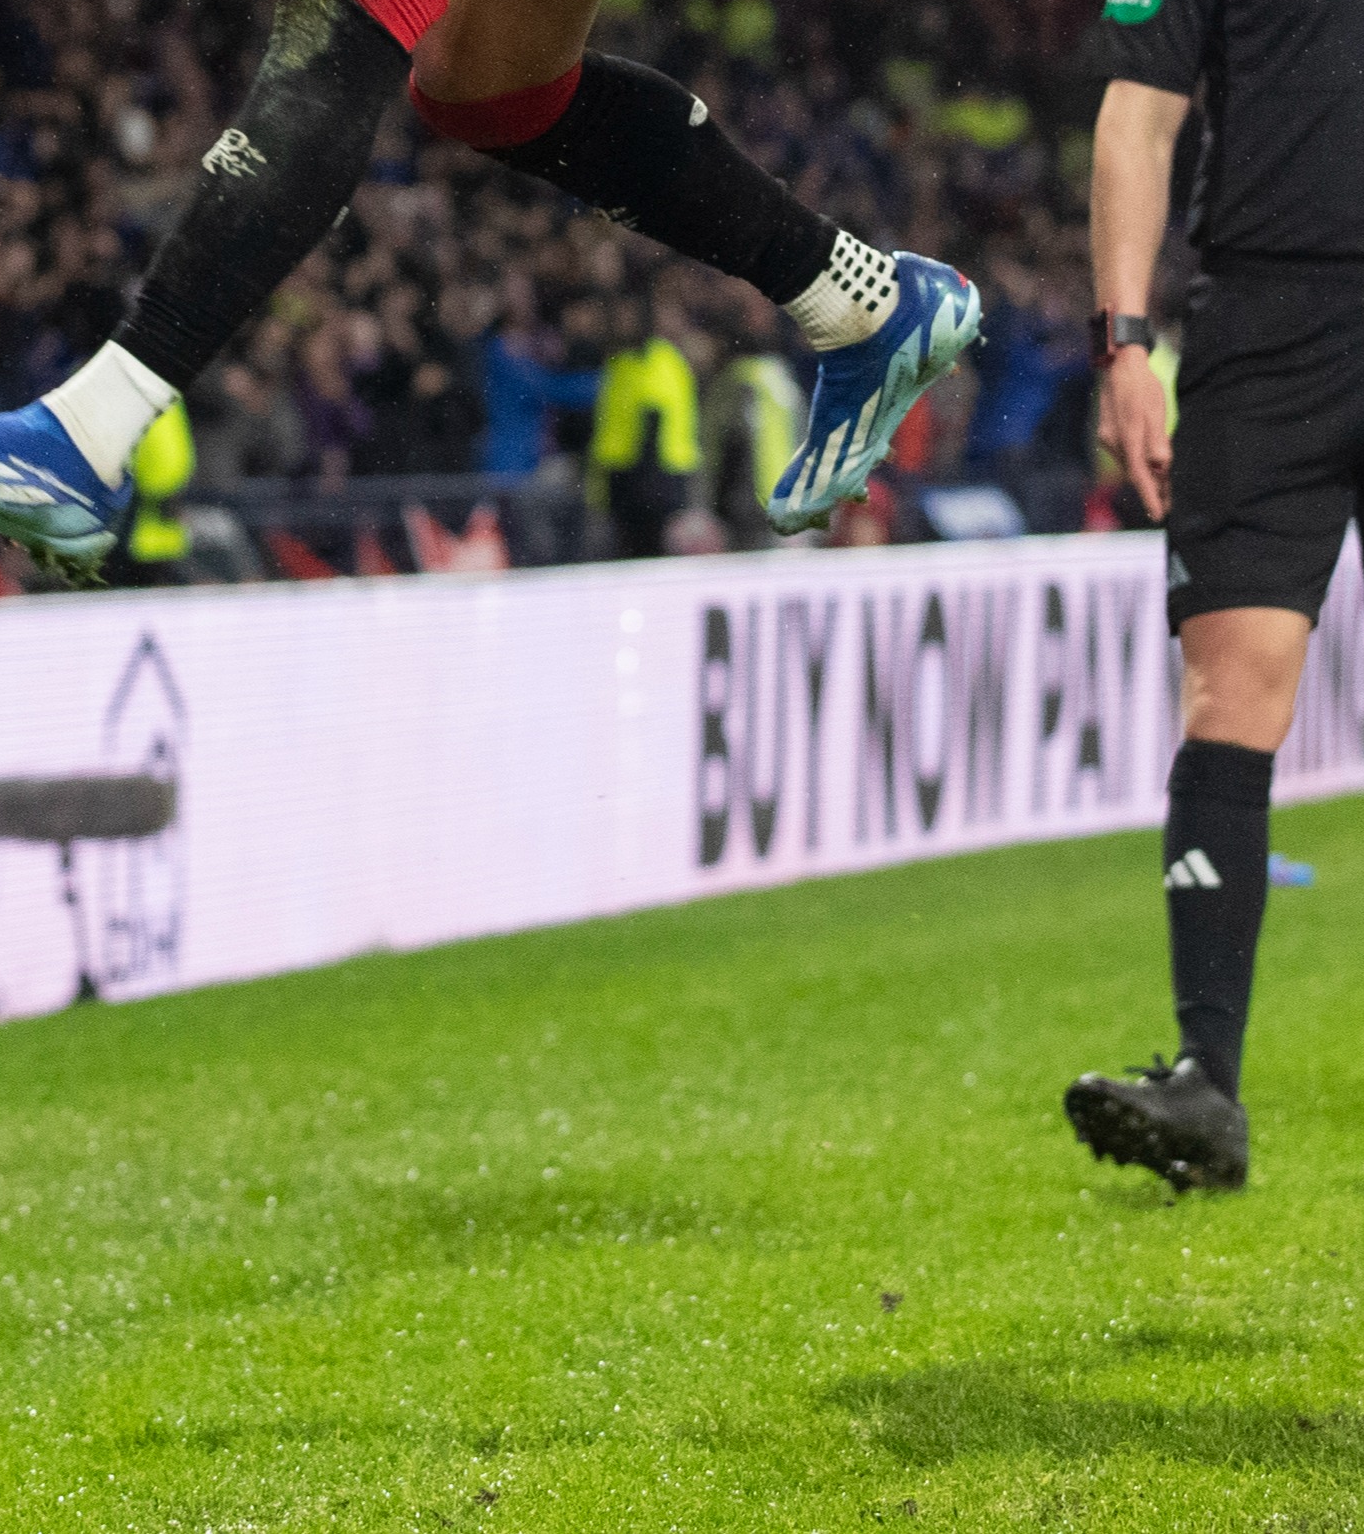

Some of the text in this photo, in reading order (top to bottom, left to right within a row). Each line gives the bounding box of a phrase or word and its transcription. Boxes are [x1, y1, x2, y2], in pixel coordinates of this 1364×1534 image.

[700, 588, 836, 868] BUY
[853, 578, 1025, 847] NOW
[1033, 570, 1157, 816] PAY
